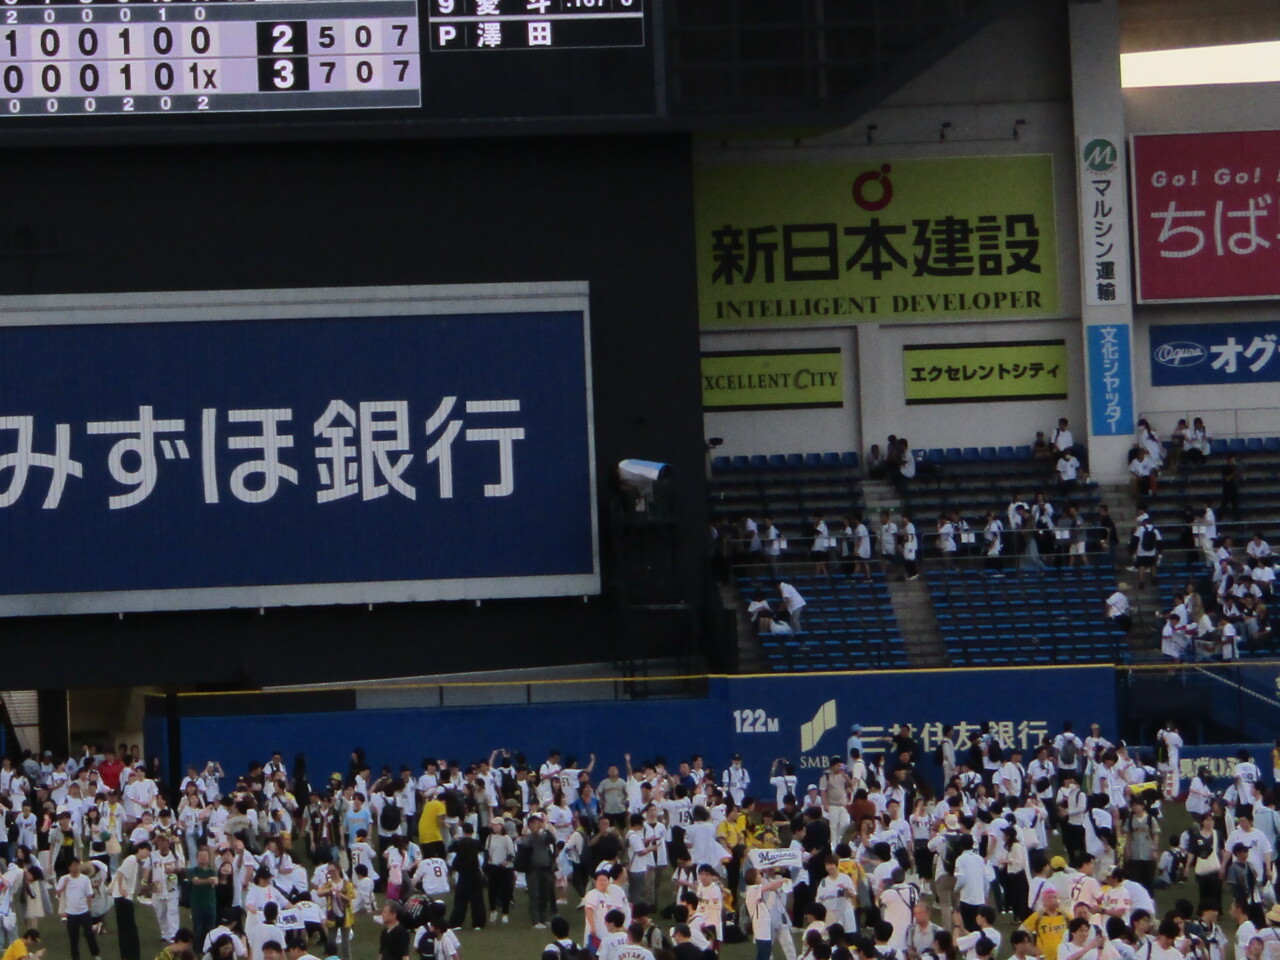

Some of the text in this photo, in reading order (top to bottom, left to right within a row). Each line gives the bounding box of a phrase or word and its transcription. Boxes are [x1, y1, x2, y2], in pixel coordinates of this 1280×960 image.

[272, 24, 294, 53] 2
[318, 26, 336, 49] 5
[354, 25, 372, 48] 0
[391, 24, 409, 47] 7
[189, 62, 217, 90] 1x
[273, 59, 295, 89] 3
[319, 61, 336, 84] 7
[356, 60, 374, 84] 0
[393, 59, 410, 82] 7
[1151, 166, 1262, 188] Go! Go!
[1091, 179, 1116, 302] マルシン運輸
[1151, 194, 1280, 258] ちば
[710, 213, 1042, 286] 新日本建設
[716, 290, 1043, 320] INTELLIGENT DEVELOPER
[1209, 333, 1280, 374] オグ
[911, 362, 1061, 384] エクセレントシティ
[799, 755, 842, 769] SMB
[432, 866, 443, 878] 8
[758, 851, 798, 867] Marines
[1040, 922, 1067, 935] Tiger
